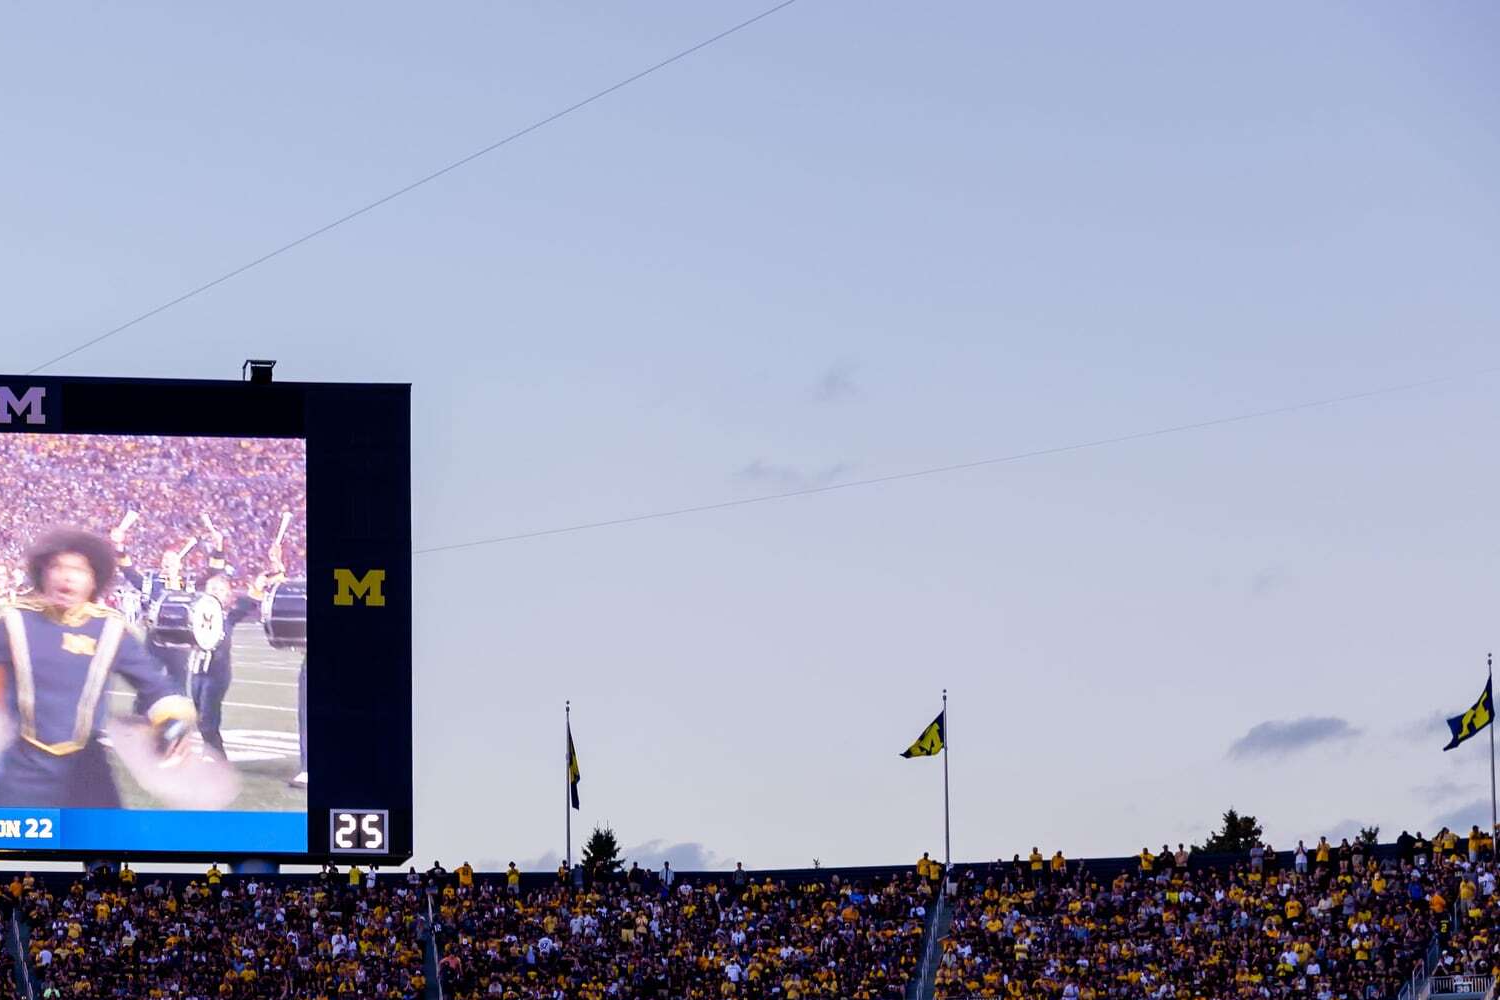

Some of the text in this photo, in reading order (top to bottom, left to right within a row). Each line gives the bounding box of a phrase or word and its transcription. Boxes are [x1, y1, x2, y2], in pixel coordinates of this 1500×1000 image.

[334, 569, 385, 606] M
[24, 818, 53, 839] 22
[335, 813, 383, 849] 25
